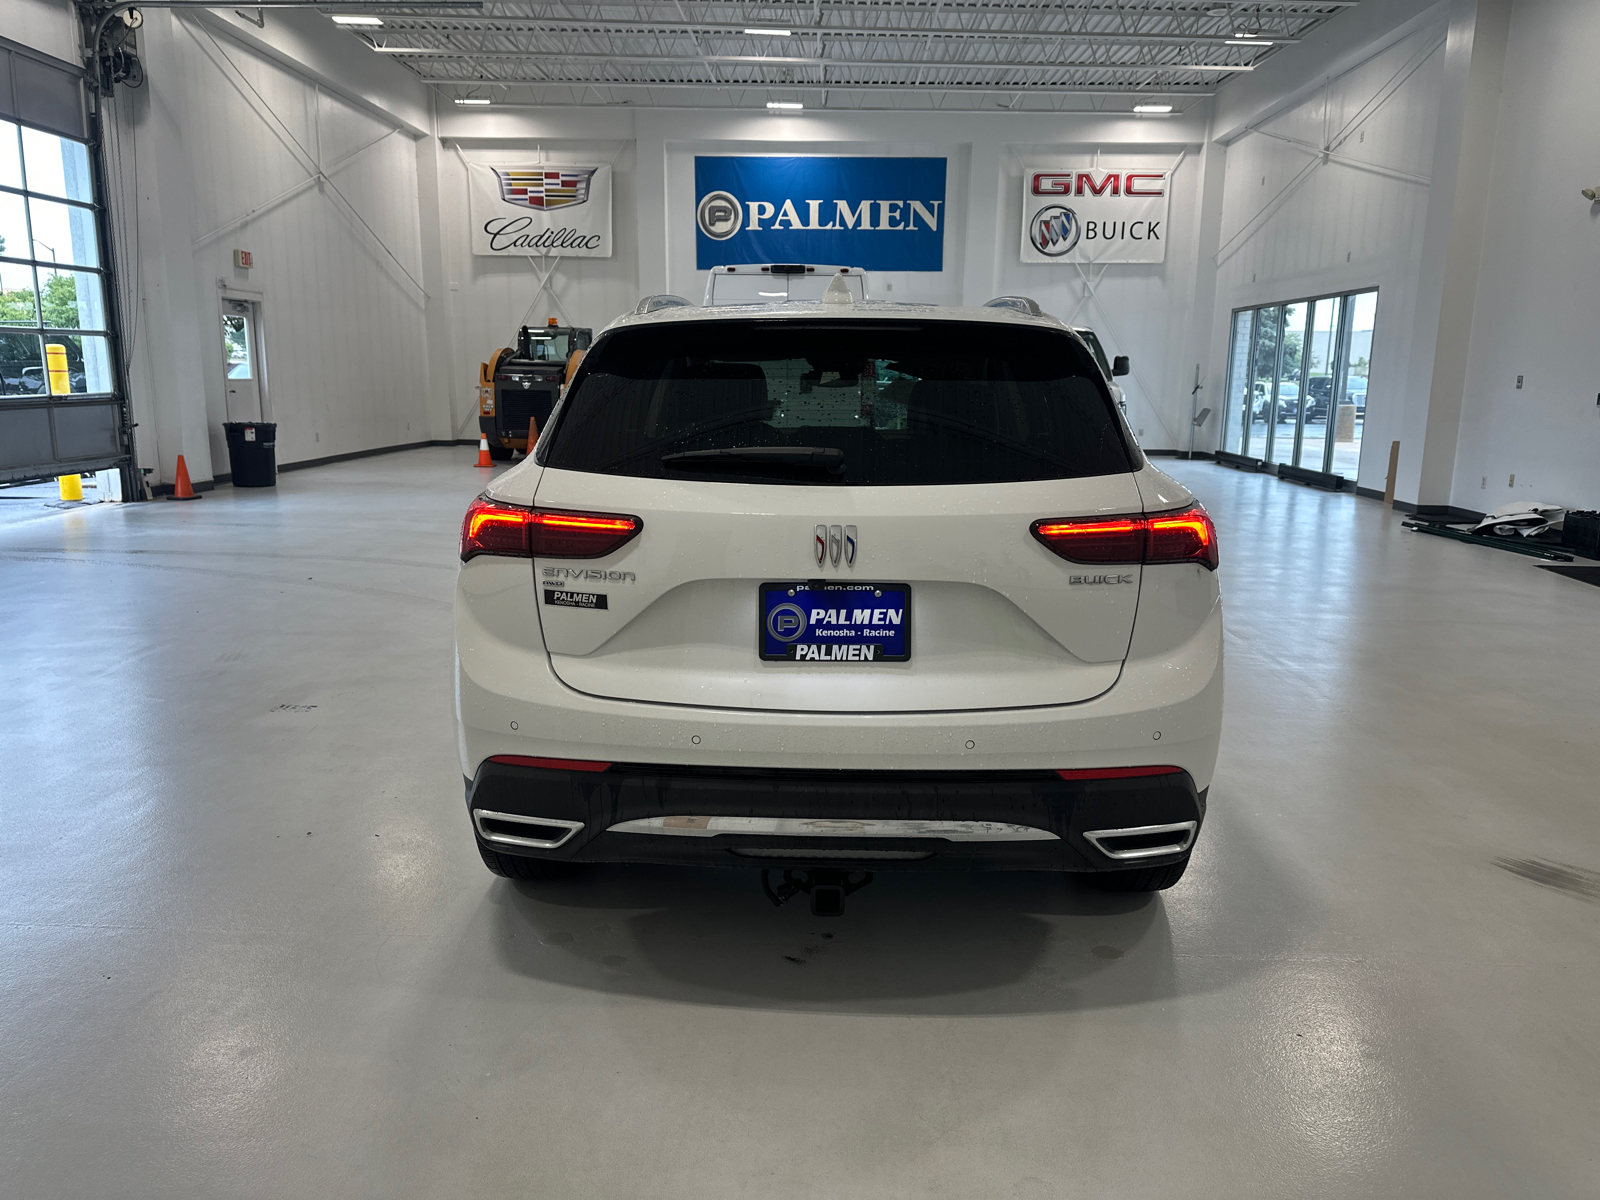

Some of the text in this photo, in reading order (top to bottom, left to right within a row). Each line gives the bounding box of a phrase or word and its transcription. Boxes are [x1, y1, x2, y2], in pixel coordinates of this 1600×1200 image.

[1031, 172, 1165, 197] GMC
[745, 199, 942, 231] PALMEN
[484, 217, 601, 251] Cadillac
[1086, 221, 1161, 240] BUICK
[1069, 574, 1133, 585] BUICK
[554, 591, 597, 603] PALMEN
[809, 609, 903, 625] PALMEN
[816, 628, 855, 637] Kenosha
[863, 628, 895, 637] Racine
[795, 644, 875, 661] PALMEN
